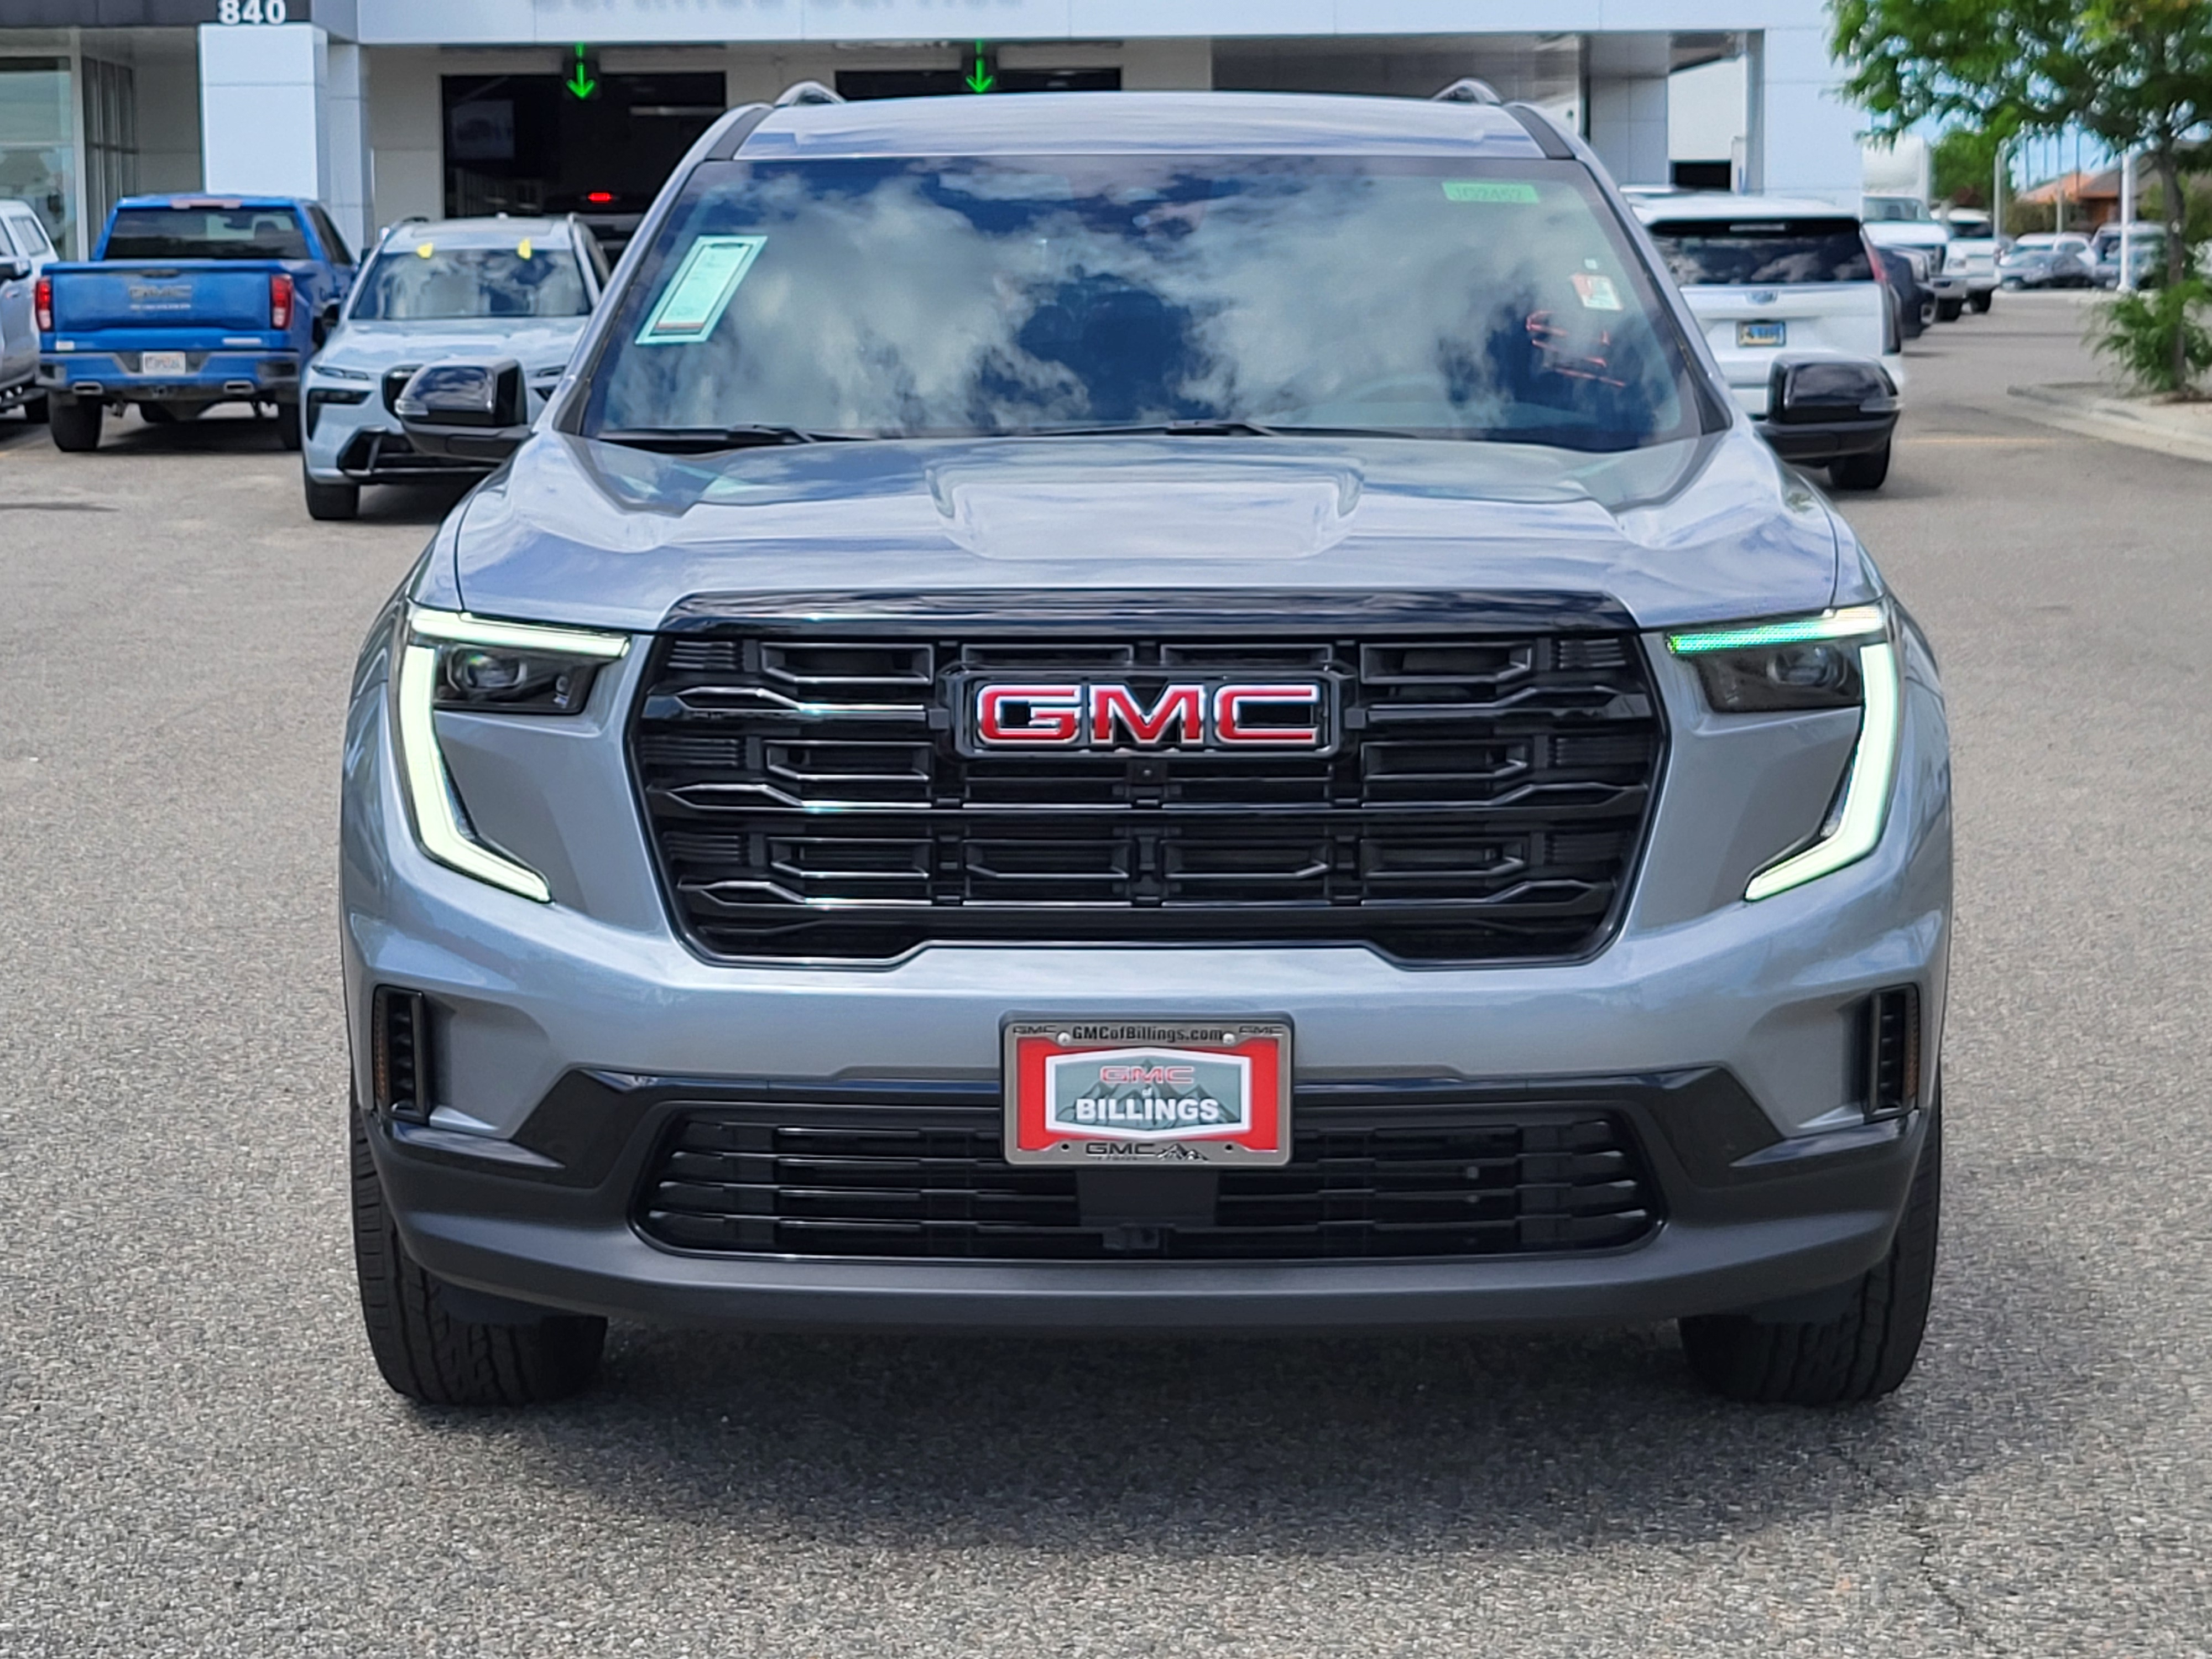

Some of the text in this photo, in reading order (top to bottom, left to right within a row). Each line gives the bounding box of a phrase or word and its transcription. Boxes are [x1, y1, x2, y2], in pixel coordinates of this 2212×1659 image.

[218, 0, 286, 25] 840
[977, 684, 1320, 744] GMC
[1013, 1025, 1057, 1034] GMC
[1072, 1025, 1223, 1044] GMCofBillings.com
[1239, 1025, 1284, 1035] GMC
[1100, 1065, 1194, 1084] GMC
[1076, 1098, 1219, 1120] BILLINGS
[1086, 1142, 1155, 1155] GMC
